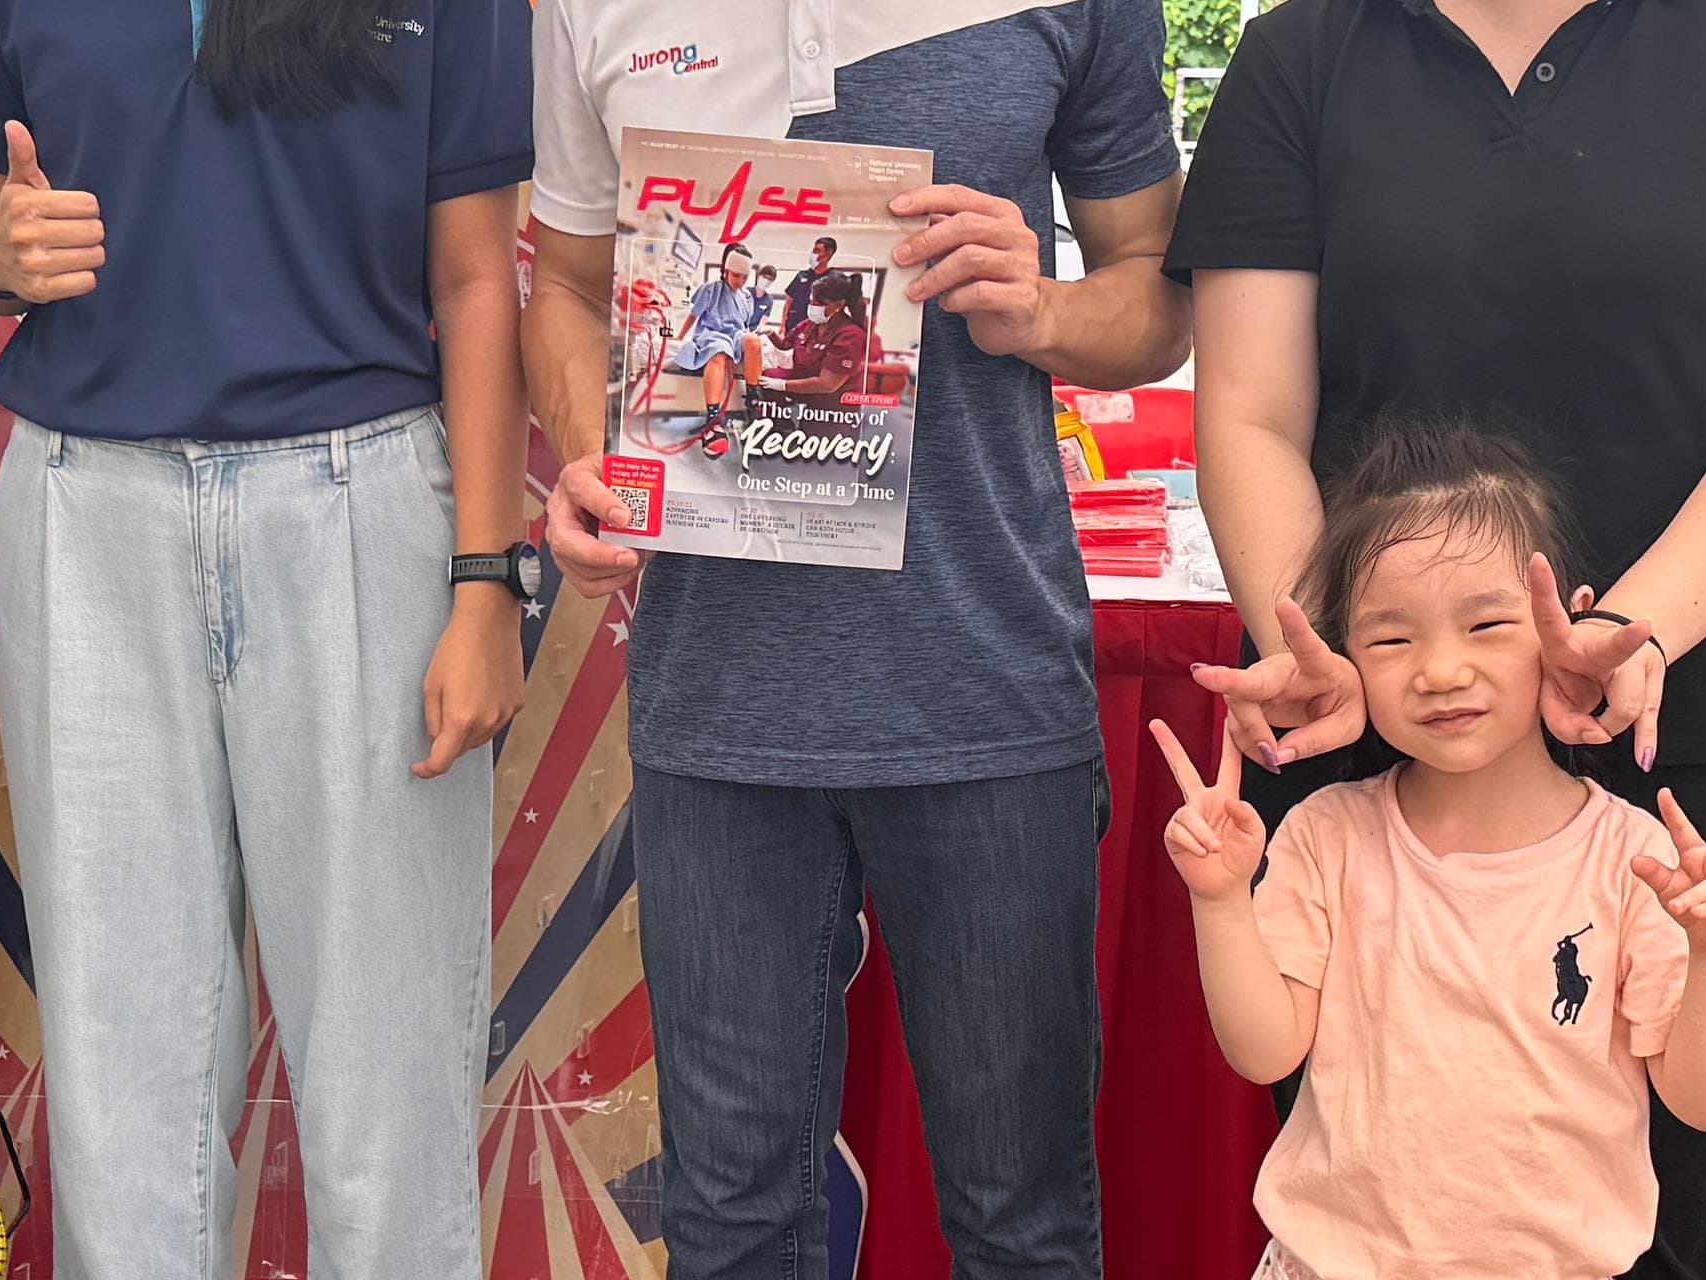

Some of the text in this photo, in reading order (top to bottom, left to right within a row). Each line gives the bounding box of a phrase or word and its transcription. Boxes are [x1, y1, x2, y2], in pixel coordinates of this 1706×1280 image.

[628, 43, 698, 73] Jurong
[796, 403, 864, 429] Journey
[868, 410, 889, 427] of
[737, 472, 896, 501] One Step at a Time
